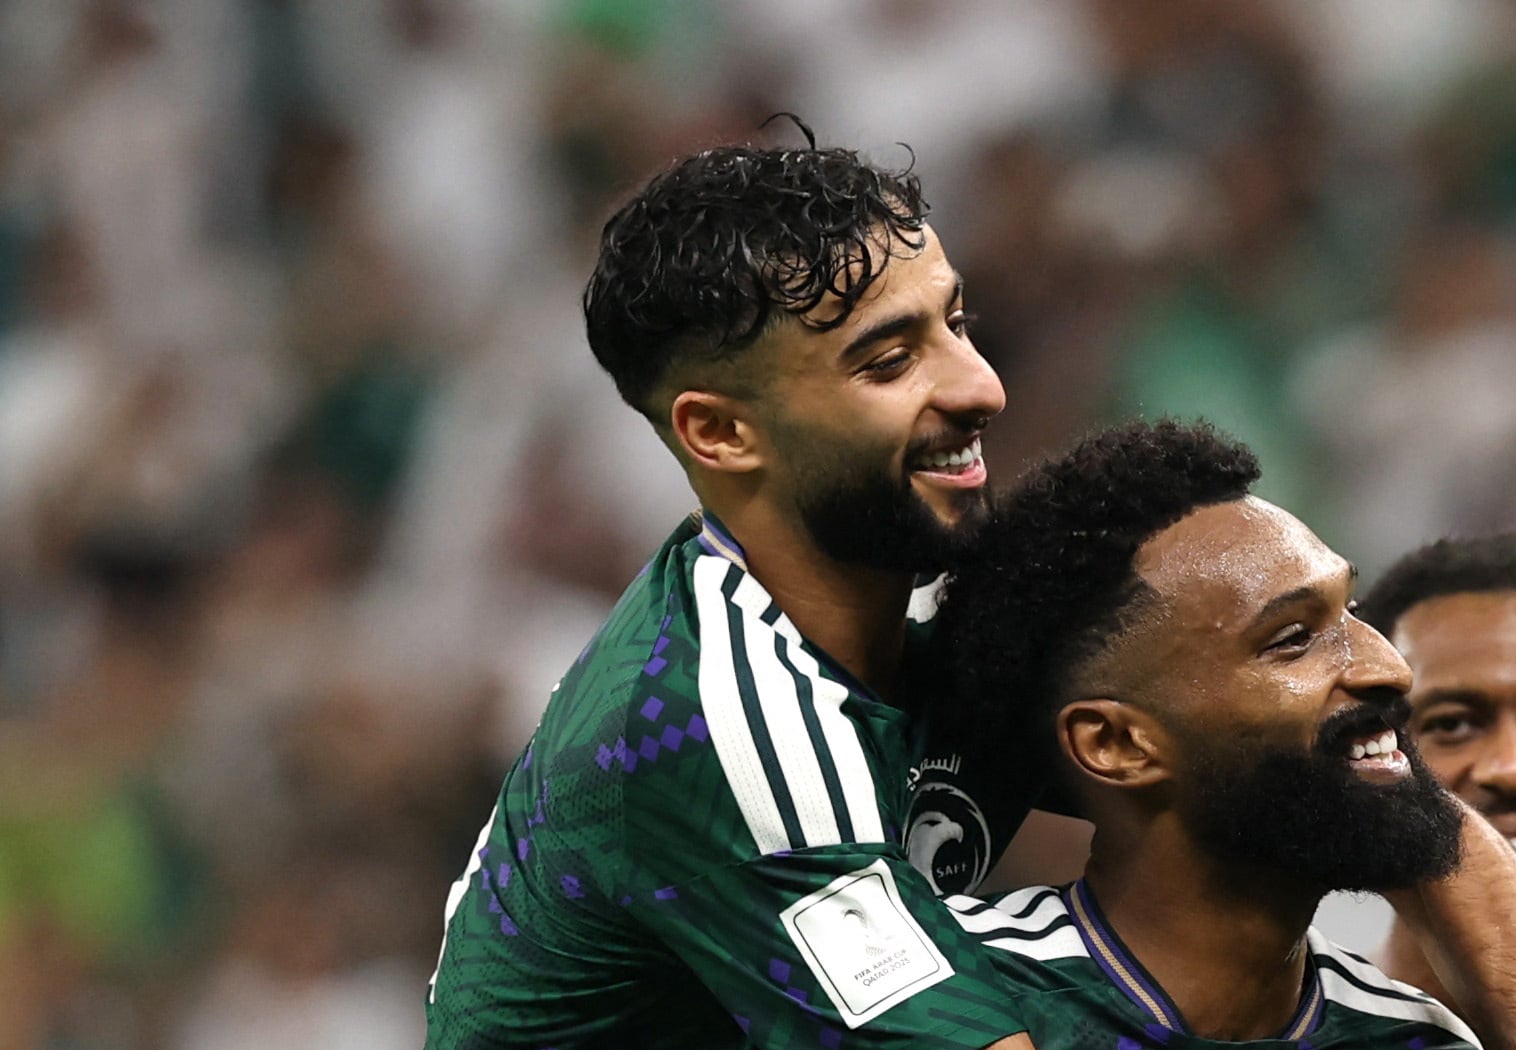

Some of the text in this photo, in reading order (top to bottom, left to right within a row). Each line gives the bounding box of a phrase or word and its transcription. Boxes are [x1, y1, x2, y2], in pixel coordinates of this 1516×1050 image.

[854, 968, 871, 981] FIFA
[872, 956, 893, 970] ARAB
[862, 957, 911, 987] QATAR 2025
